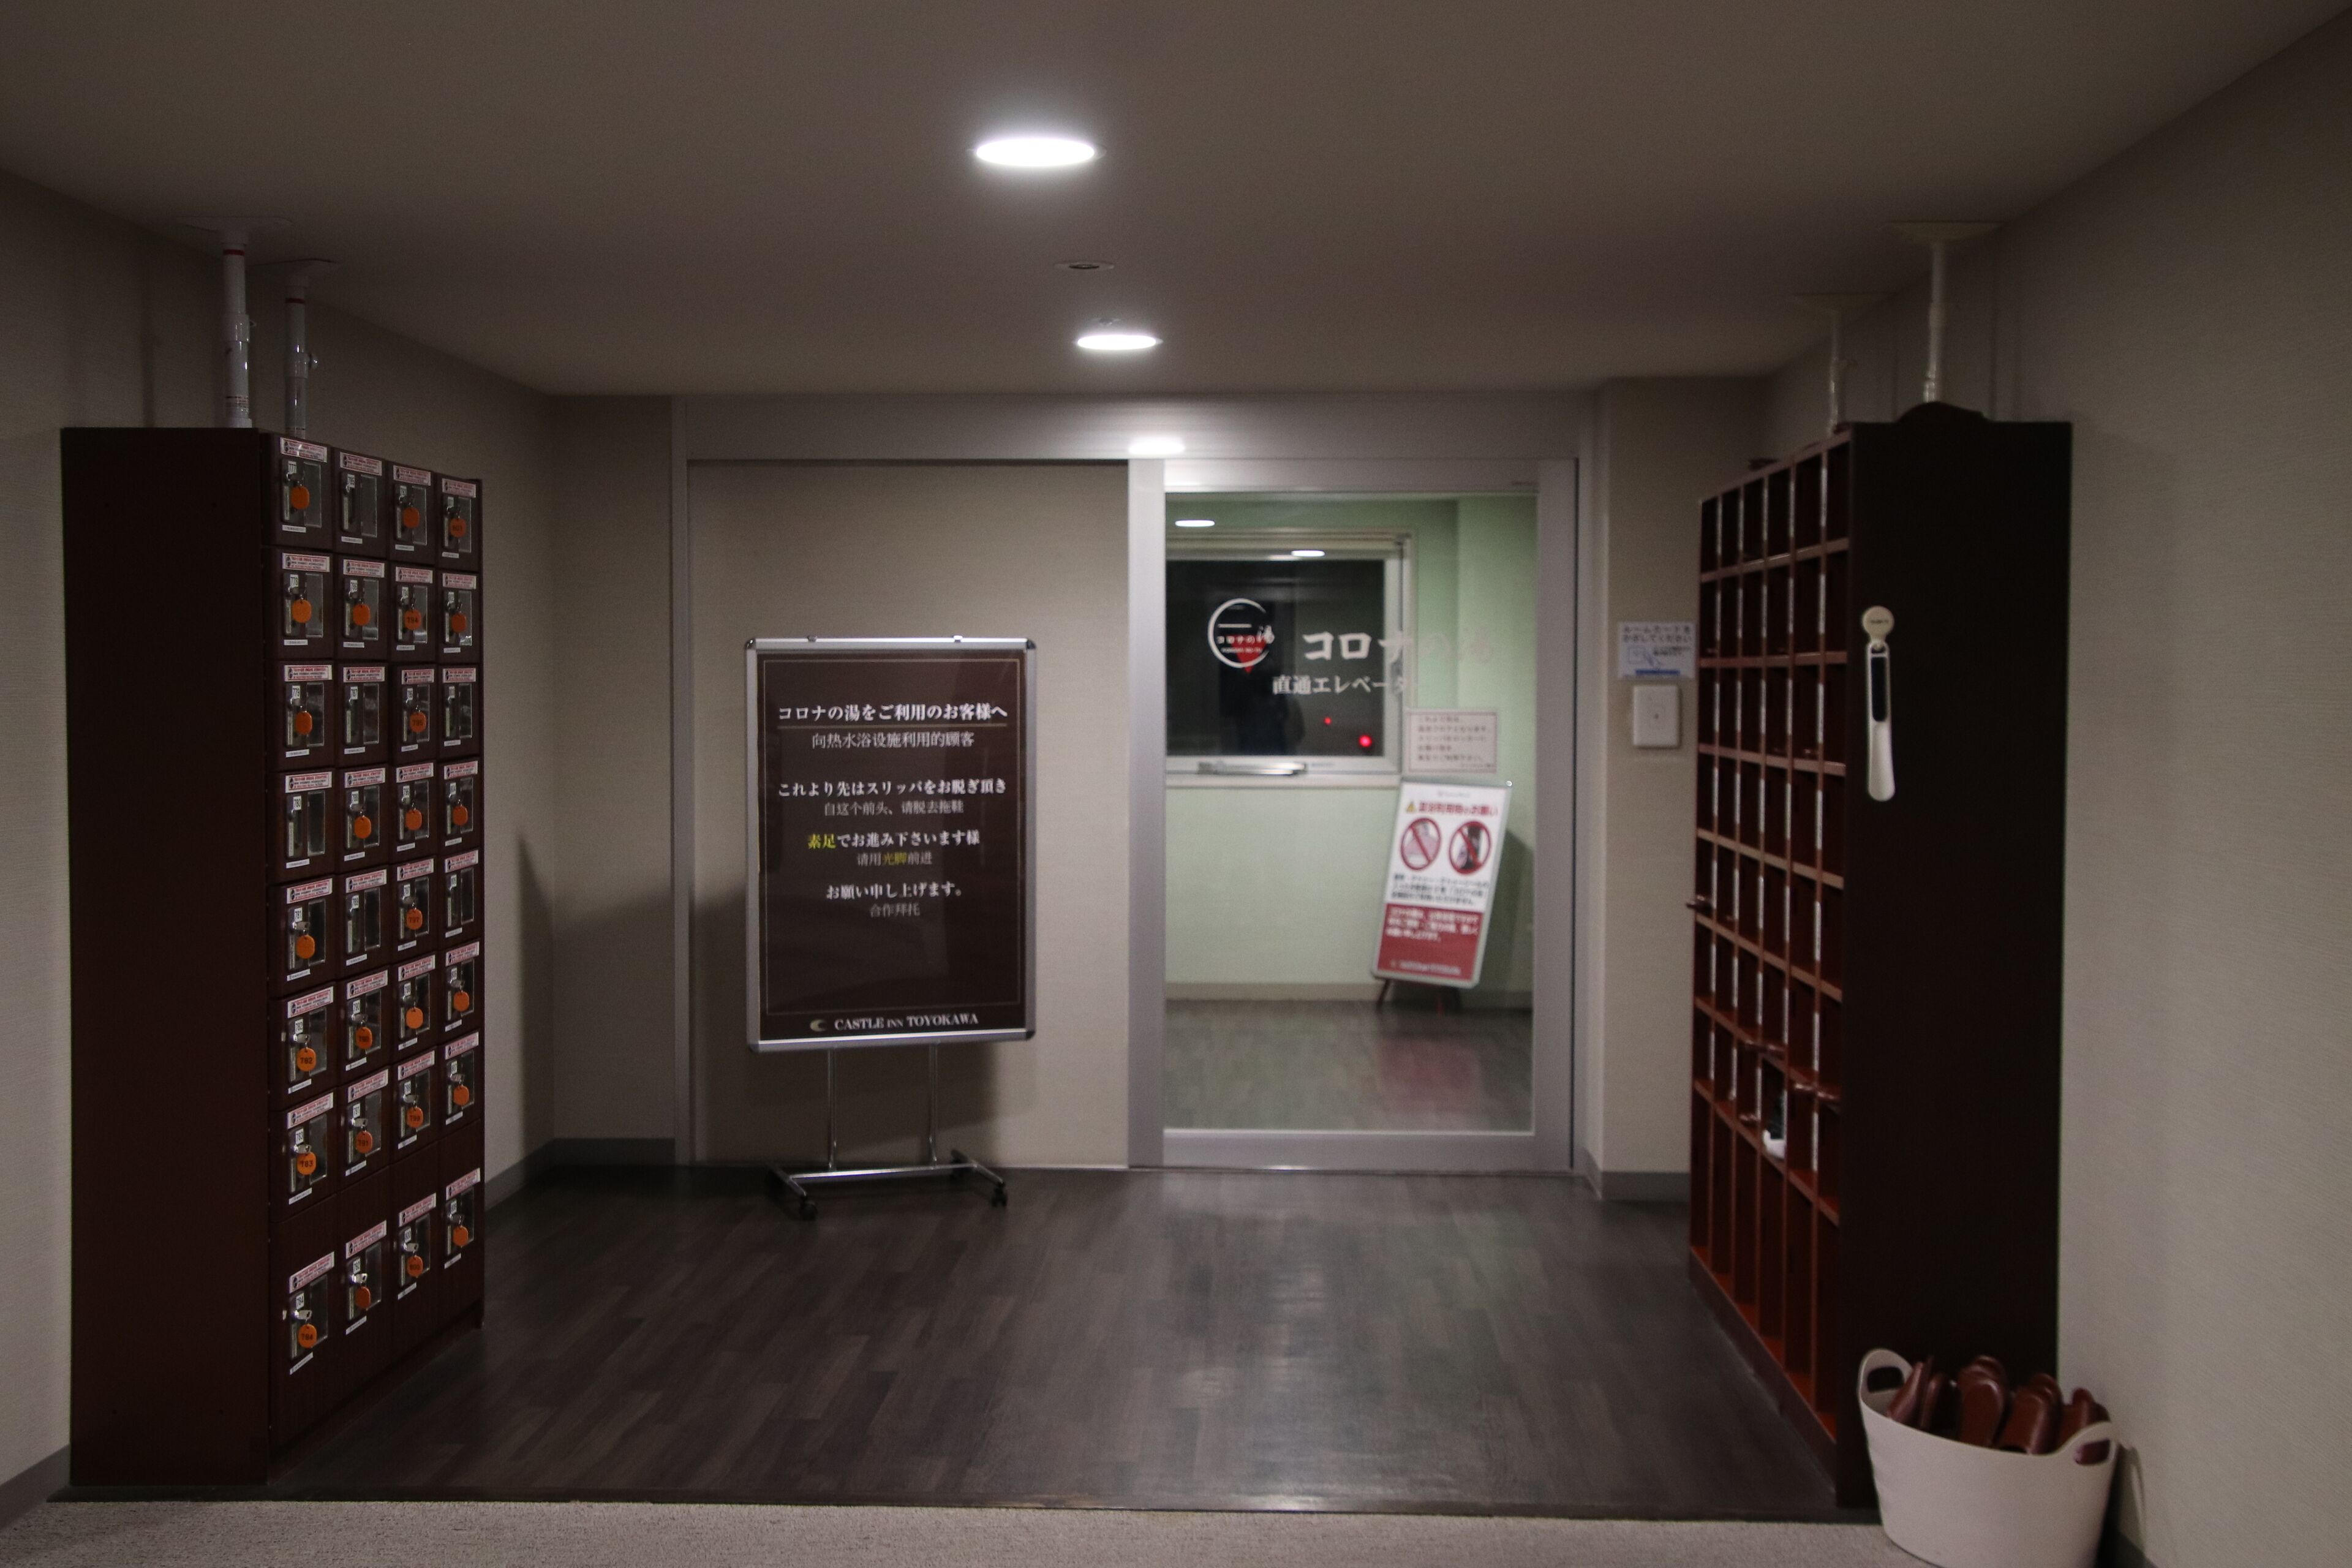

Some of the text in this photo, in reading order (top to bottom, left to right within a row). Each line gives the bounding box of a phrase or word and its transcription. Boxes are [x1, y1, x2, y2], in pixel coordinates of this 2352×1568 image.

[778, 703, 1008, 723] コロナの湯をご利用のお客様へ
[778, 778, 1007, 797] これより先はスリッパをお脱ぎ頂き
[808, 829, 981, 850] 素足でお進み下さいます様
[826, 881, 962, 900] お願い申し上げます。
[834, 1012, 979, 1031] CASTLE INN TOYOKAWA
